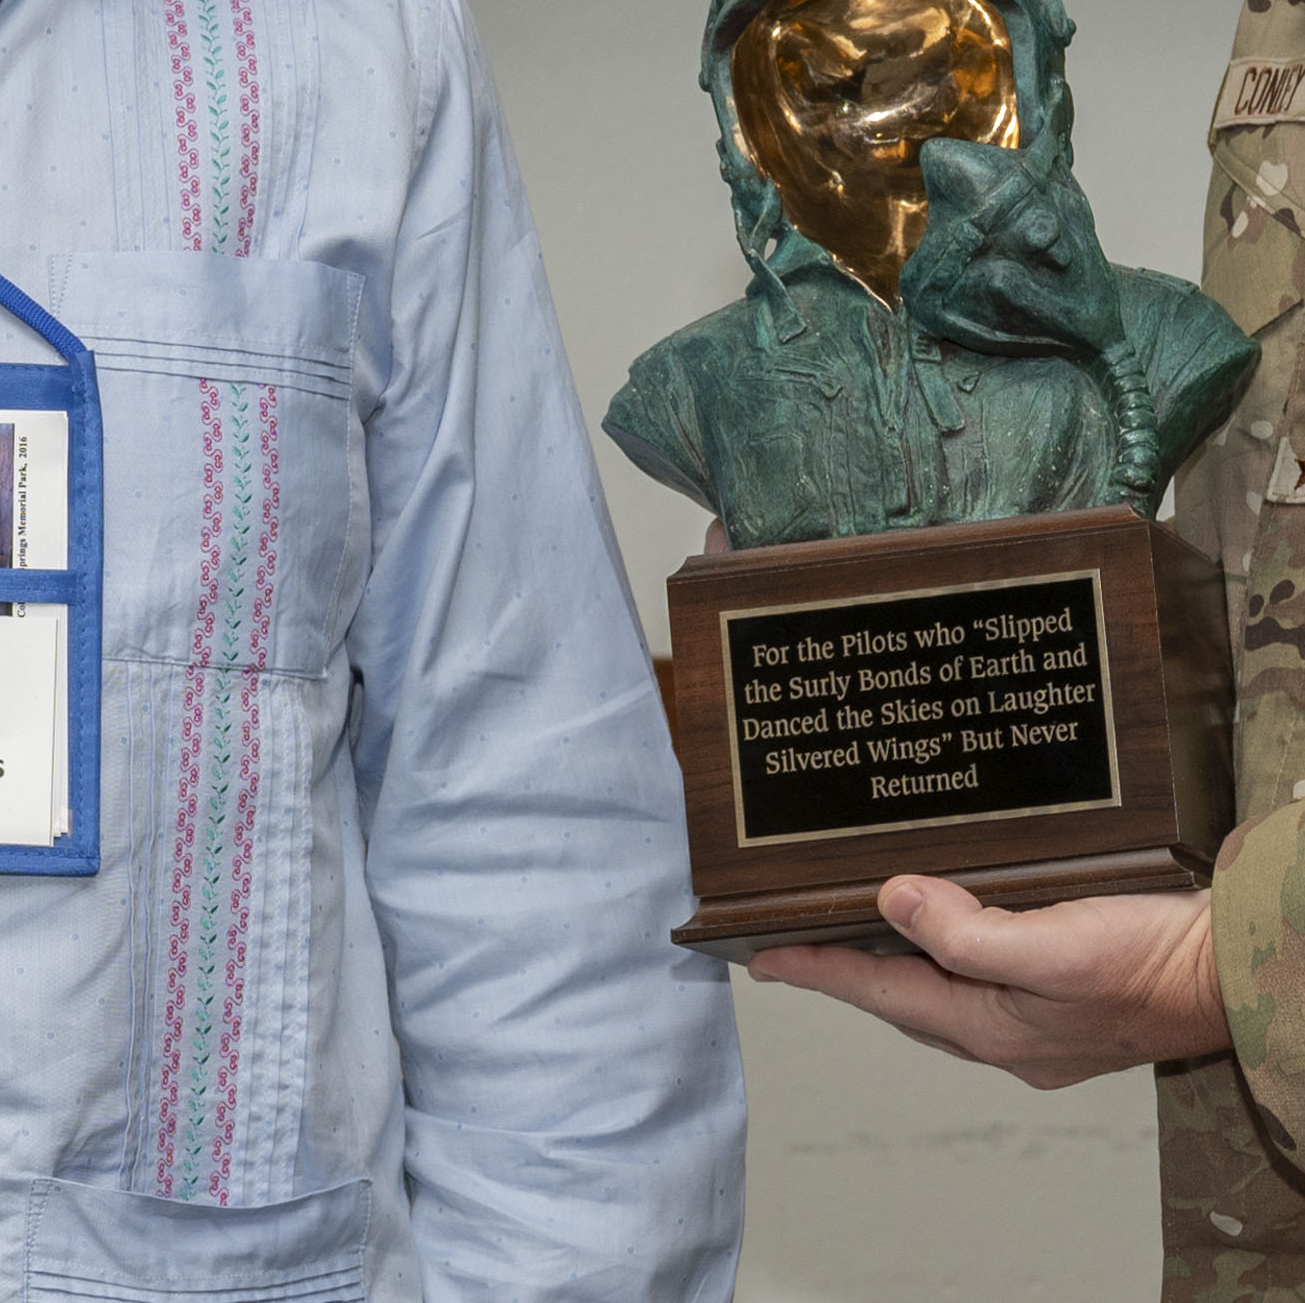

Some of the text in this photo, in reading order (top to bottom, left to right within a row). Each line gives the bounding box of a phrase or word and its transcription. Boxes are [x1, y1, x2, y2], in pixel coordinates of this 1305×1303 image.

[19, 437, 27, 458] 2016
[19, 464, 28, 487] Park,
[18, 492, 26, 535] Memorial
[752, 607, 1073, 668] For the Pilots who “Slipped
[744, 642, 1088, 705] the Surly Bonds of Earth and
[742, 681, 1096, 741] Danced the Skies on Laughter
[765, 719, 1078, 775] Silvered Wings” But Never
[870, 763, 979, 800] Returned
